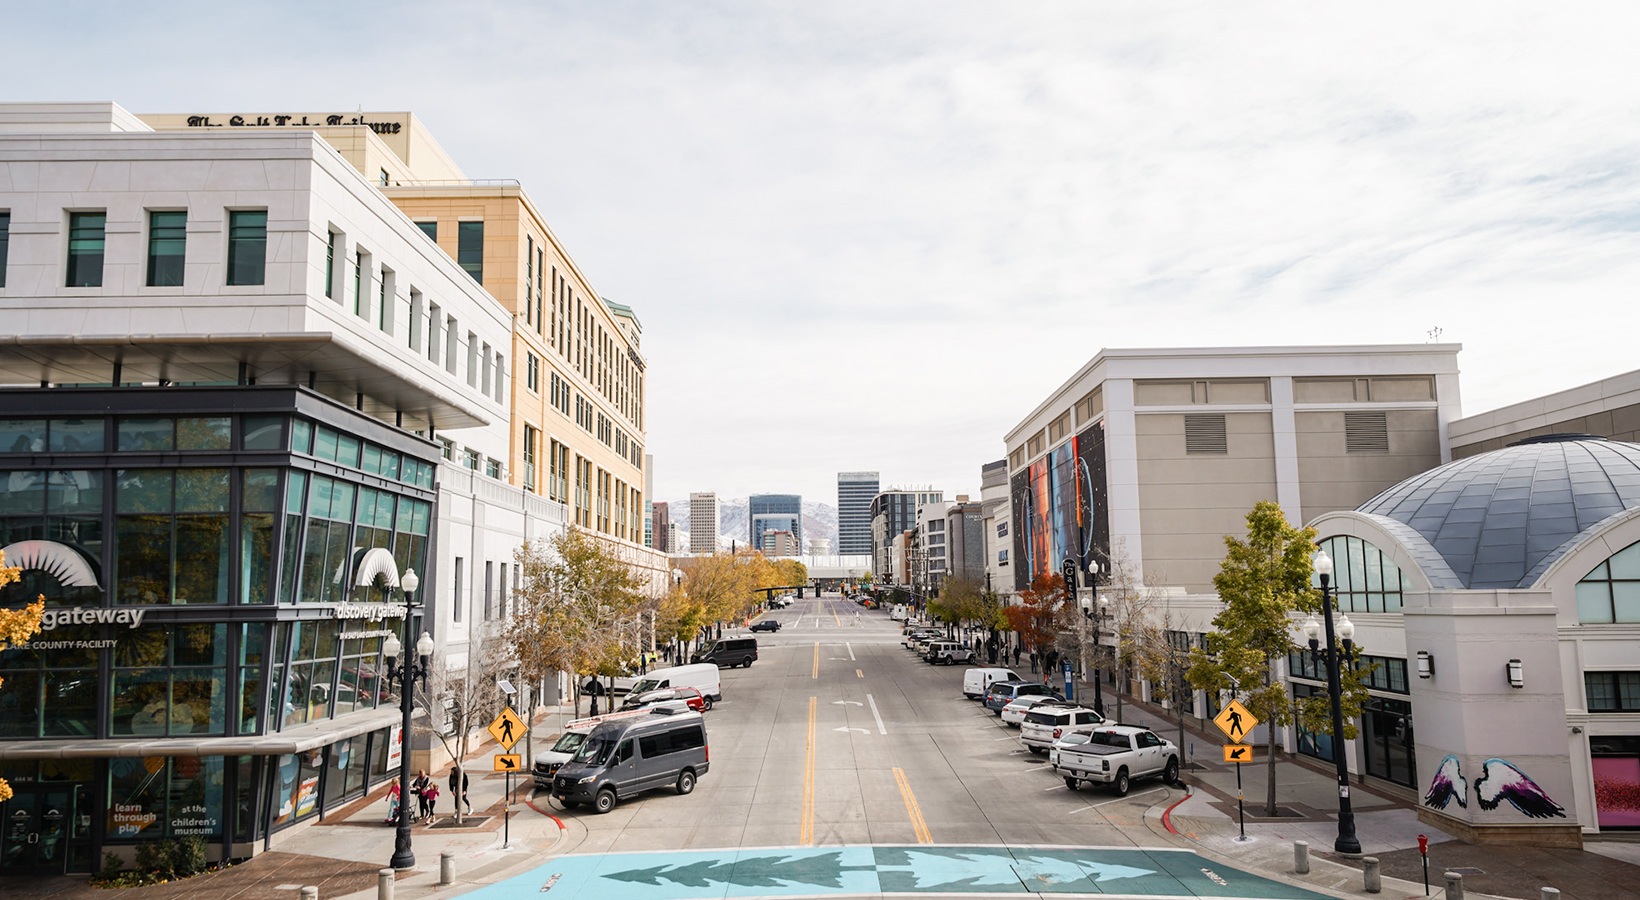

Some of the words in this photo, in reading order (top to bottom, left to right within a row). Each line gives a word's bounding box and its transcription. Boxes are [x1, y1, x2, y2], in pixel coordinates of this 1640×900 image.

[187, 115, 223, 126] Th
[229, 115, 270, 126] Slt
[274, 115, 320, 126] Lk
[337, 601, 377, 622] discovery
[377, 602, 408, 622] gateway
[42, 606, 145, 630] gateway
[33, 640, 75, 650] COUNTY
[76, 639, 118, 649] FACILITY
[115, 803, 142, 812] learn
[181, 805, 191, 814] at
[192, 804, 207, 814] the
[113, 812, 157, 823] through
[171, 817, 217, 827] children's
[118, 823, 141, 835] play
[174, 827, 214, 835] museum
